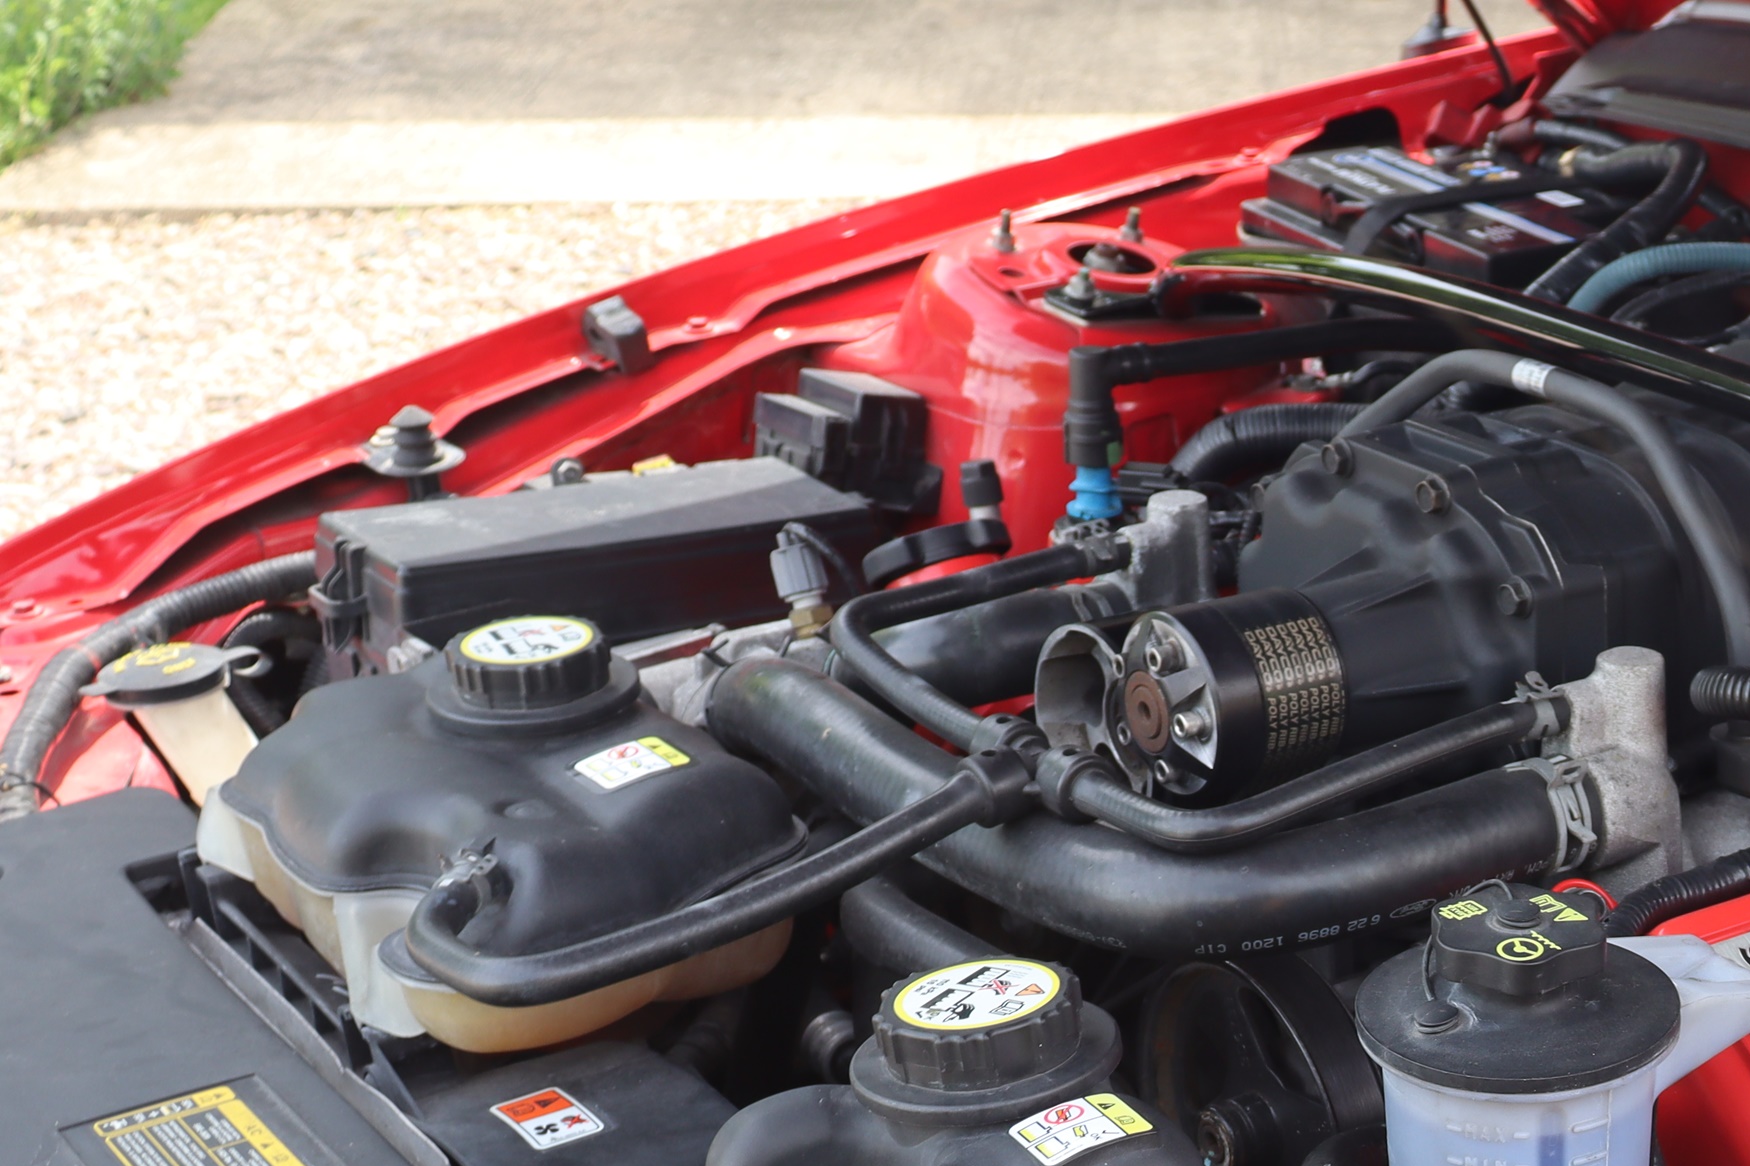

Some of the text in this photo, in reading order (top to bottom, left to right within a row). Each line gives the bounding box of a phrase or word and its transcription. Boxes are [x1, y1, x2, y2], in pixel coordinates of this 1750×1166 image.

[1267, 697, 1278, 729] POLY
[1279, 695, 1289, 727] POLY
[1288, 692, 1299, 724] POLY
[1299, 690, 1310, 721] POLY
[1309, 687, 1320, 719] POLY
[1320, 685, 1330, 716] POLY
[1330, 682, 1341, 714] POLY
[1240, 934, 1284, 952] 1200
[1297, 923, 1340, 943] 8896
